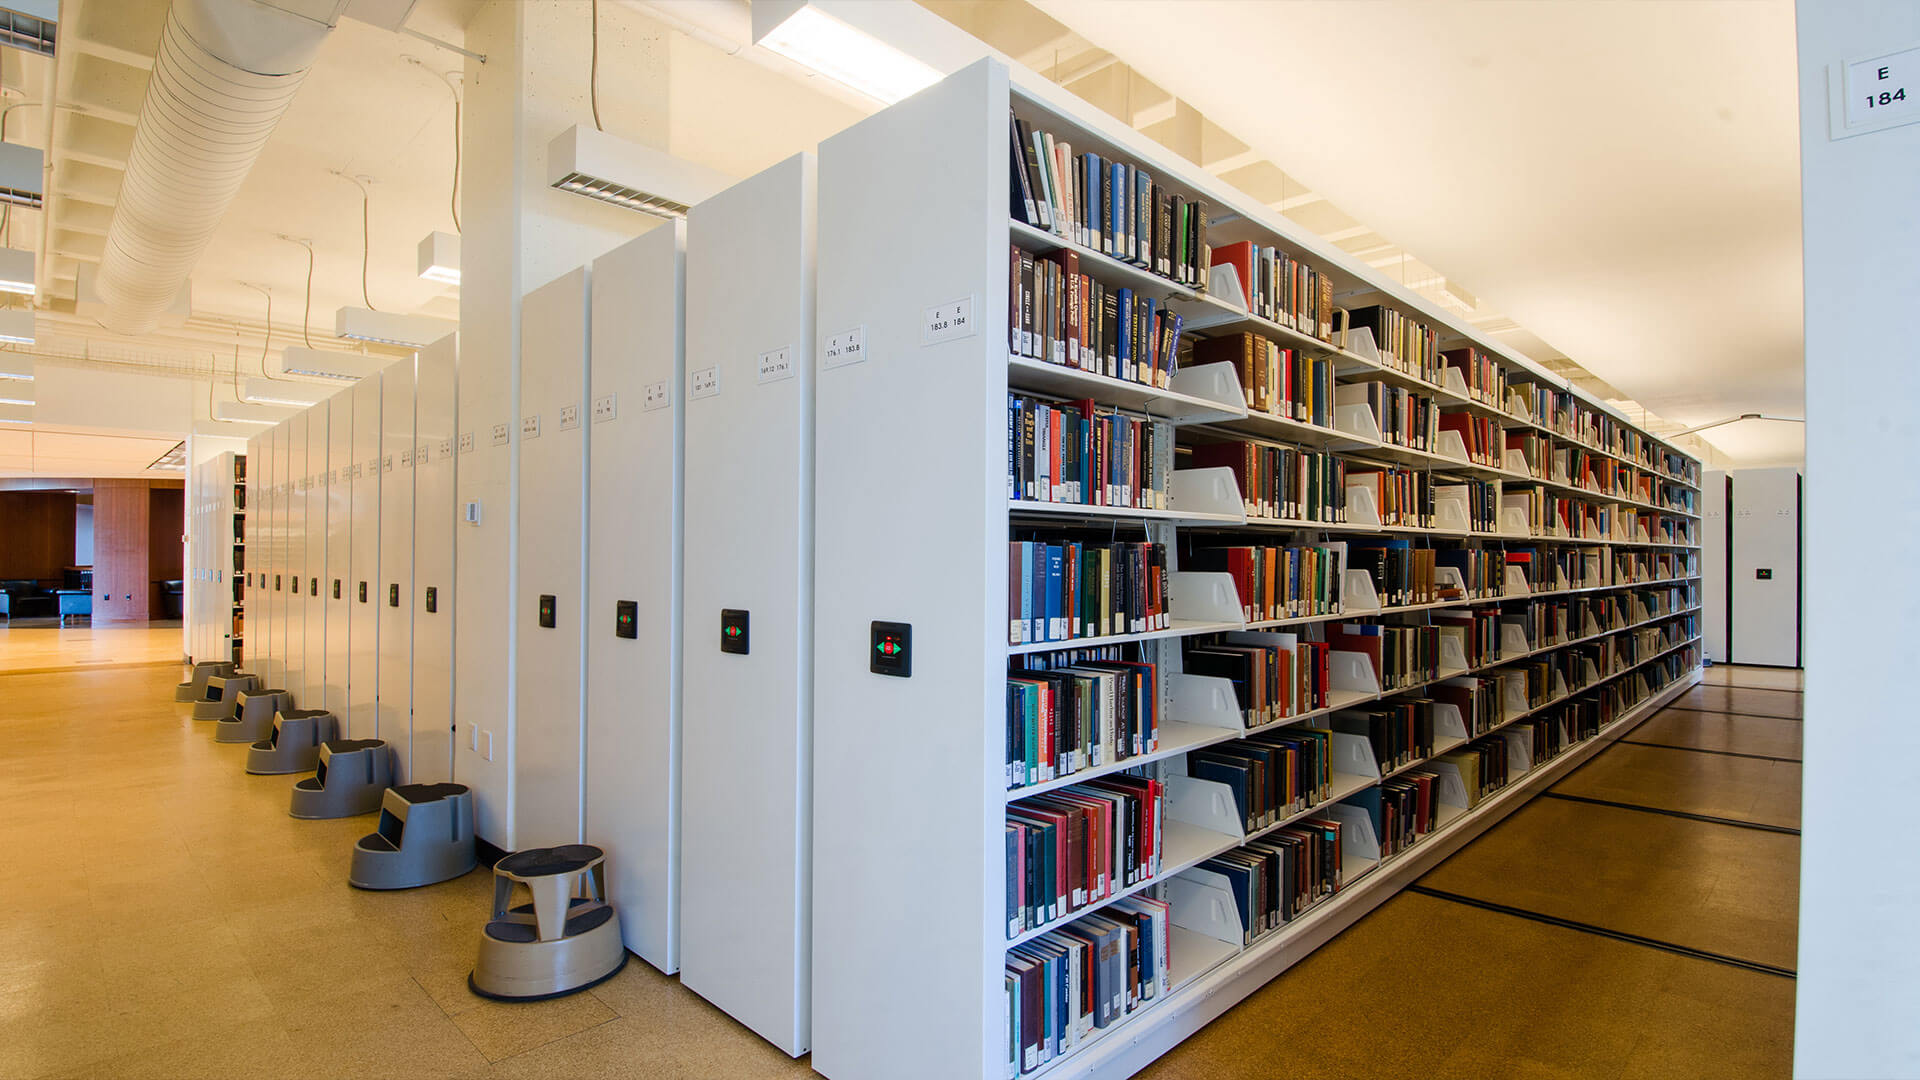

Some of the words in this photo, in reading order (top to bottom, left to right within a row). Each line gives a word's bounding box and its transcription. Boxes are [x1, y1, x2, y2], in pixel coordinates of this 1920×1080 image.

[1878, 66, 1889, 80] E
[1866, 87, 1907, 108] 184
[956, 306, 961, 314] E
[930, 321, 948, 332] 183.8
[953, 316, 966, 326] 184
[845, 344, 860, 353] 183.8
